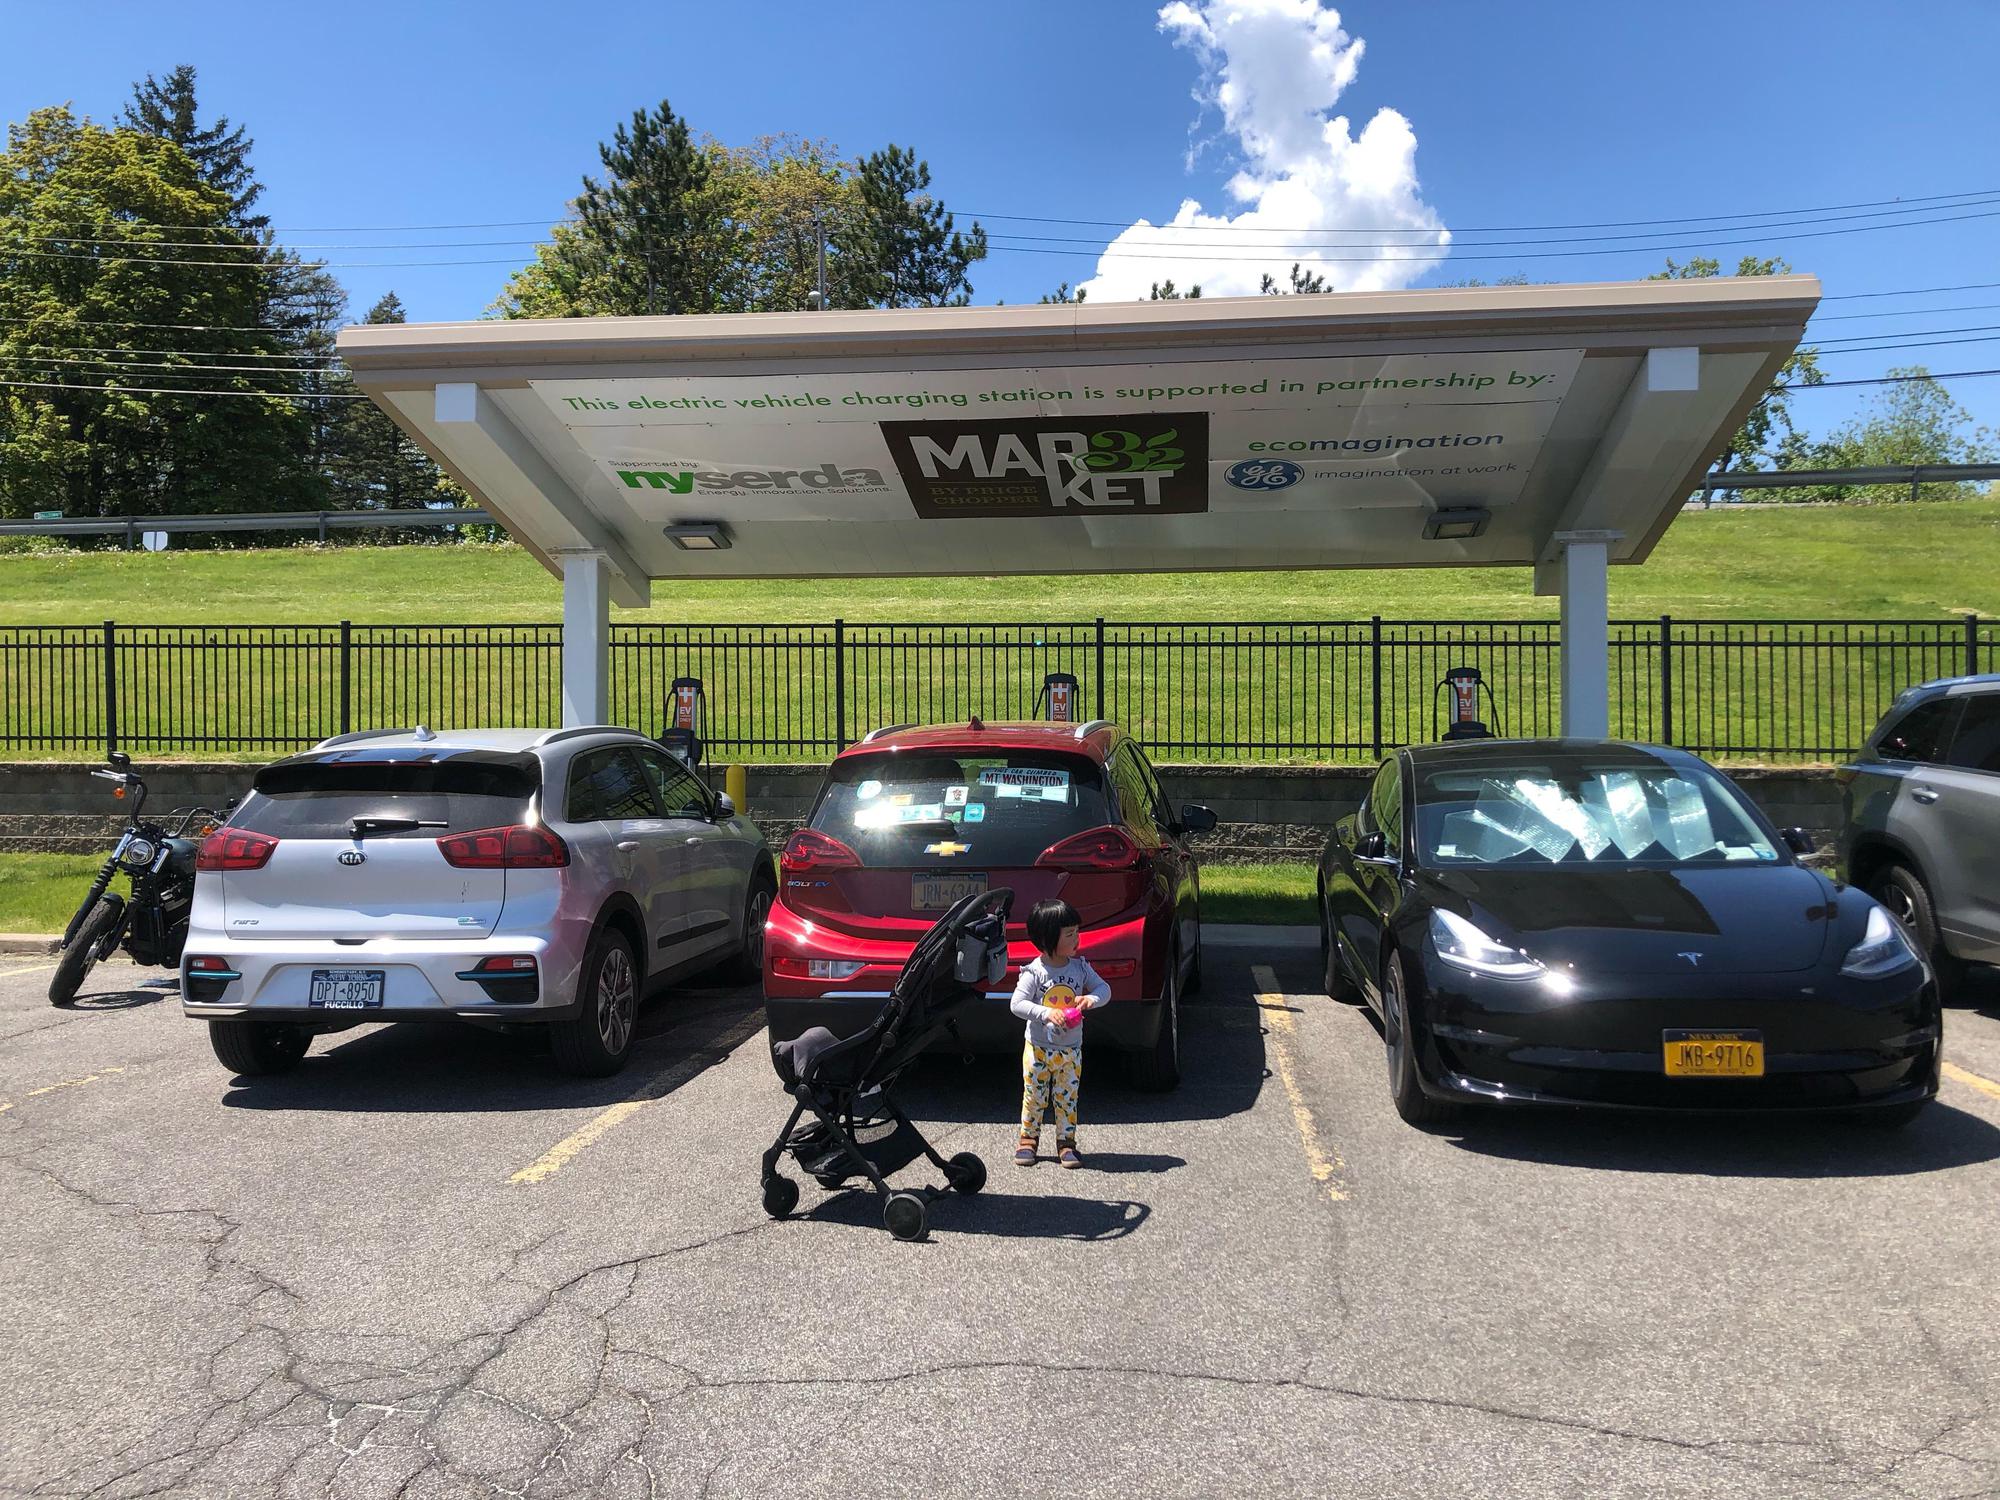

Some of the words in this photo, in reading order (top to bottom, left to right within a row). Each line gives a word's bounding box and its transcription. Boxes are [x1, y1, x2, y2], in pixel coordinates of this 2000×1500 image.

[562, 396, 620, 411] This
[627, 395, 727, 410] electric
[733, 393, 832, 409] vehicle
[841, 390, 968, 408] charging
[979, 387, 1073, 403] station
[1084, 386, 1105, 399] is
[1116, 378, 1268, 400] supported
[1280, 379, 1304, 392] in
[1316, 372, 1496, 395] partnership
[1507, 370, 1556, 388] by:
[1248, 433, 1504, 453] ecomagination
[607, 460, 678, 468] Supported
[1314, 467, 1434, 480] imagination
[1441, 465, 1462, 475] at
[1466, 461, 1517, 474] work
[616, 464, 887, 494] nyserda
[929, 487, 960, 496] BY
[966, 486, 1038, 495] PRICE
[680, 706, 692, 715] EV
[1053, 703, 1066, 711] EV
[1002, 773, 1064, 787] WASHINGTON
[341, 854, 362, 864] KIA
[1040, 975, 1081, 993] HAPPY
[324, 1000, 364, 1009] FUCCILLO
